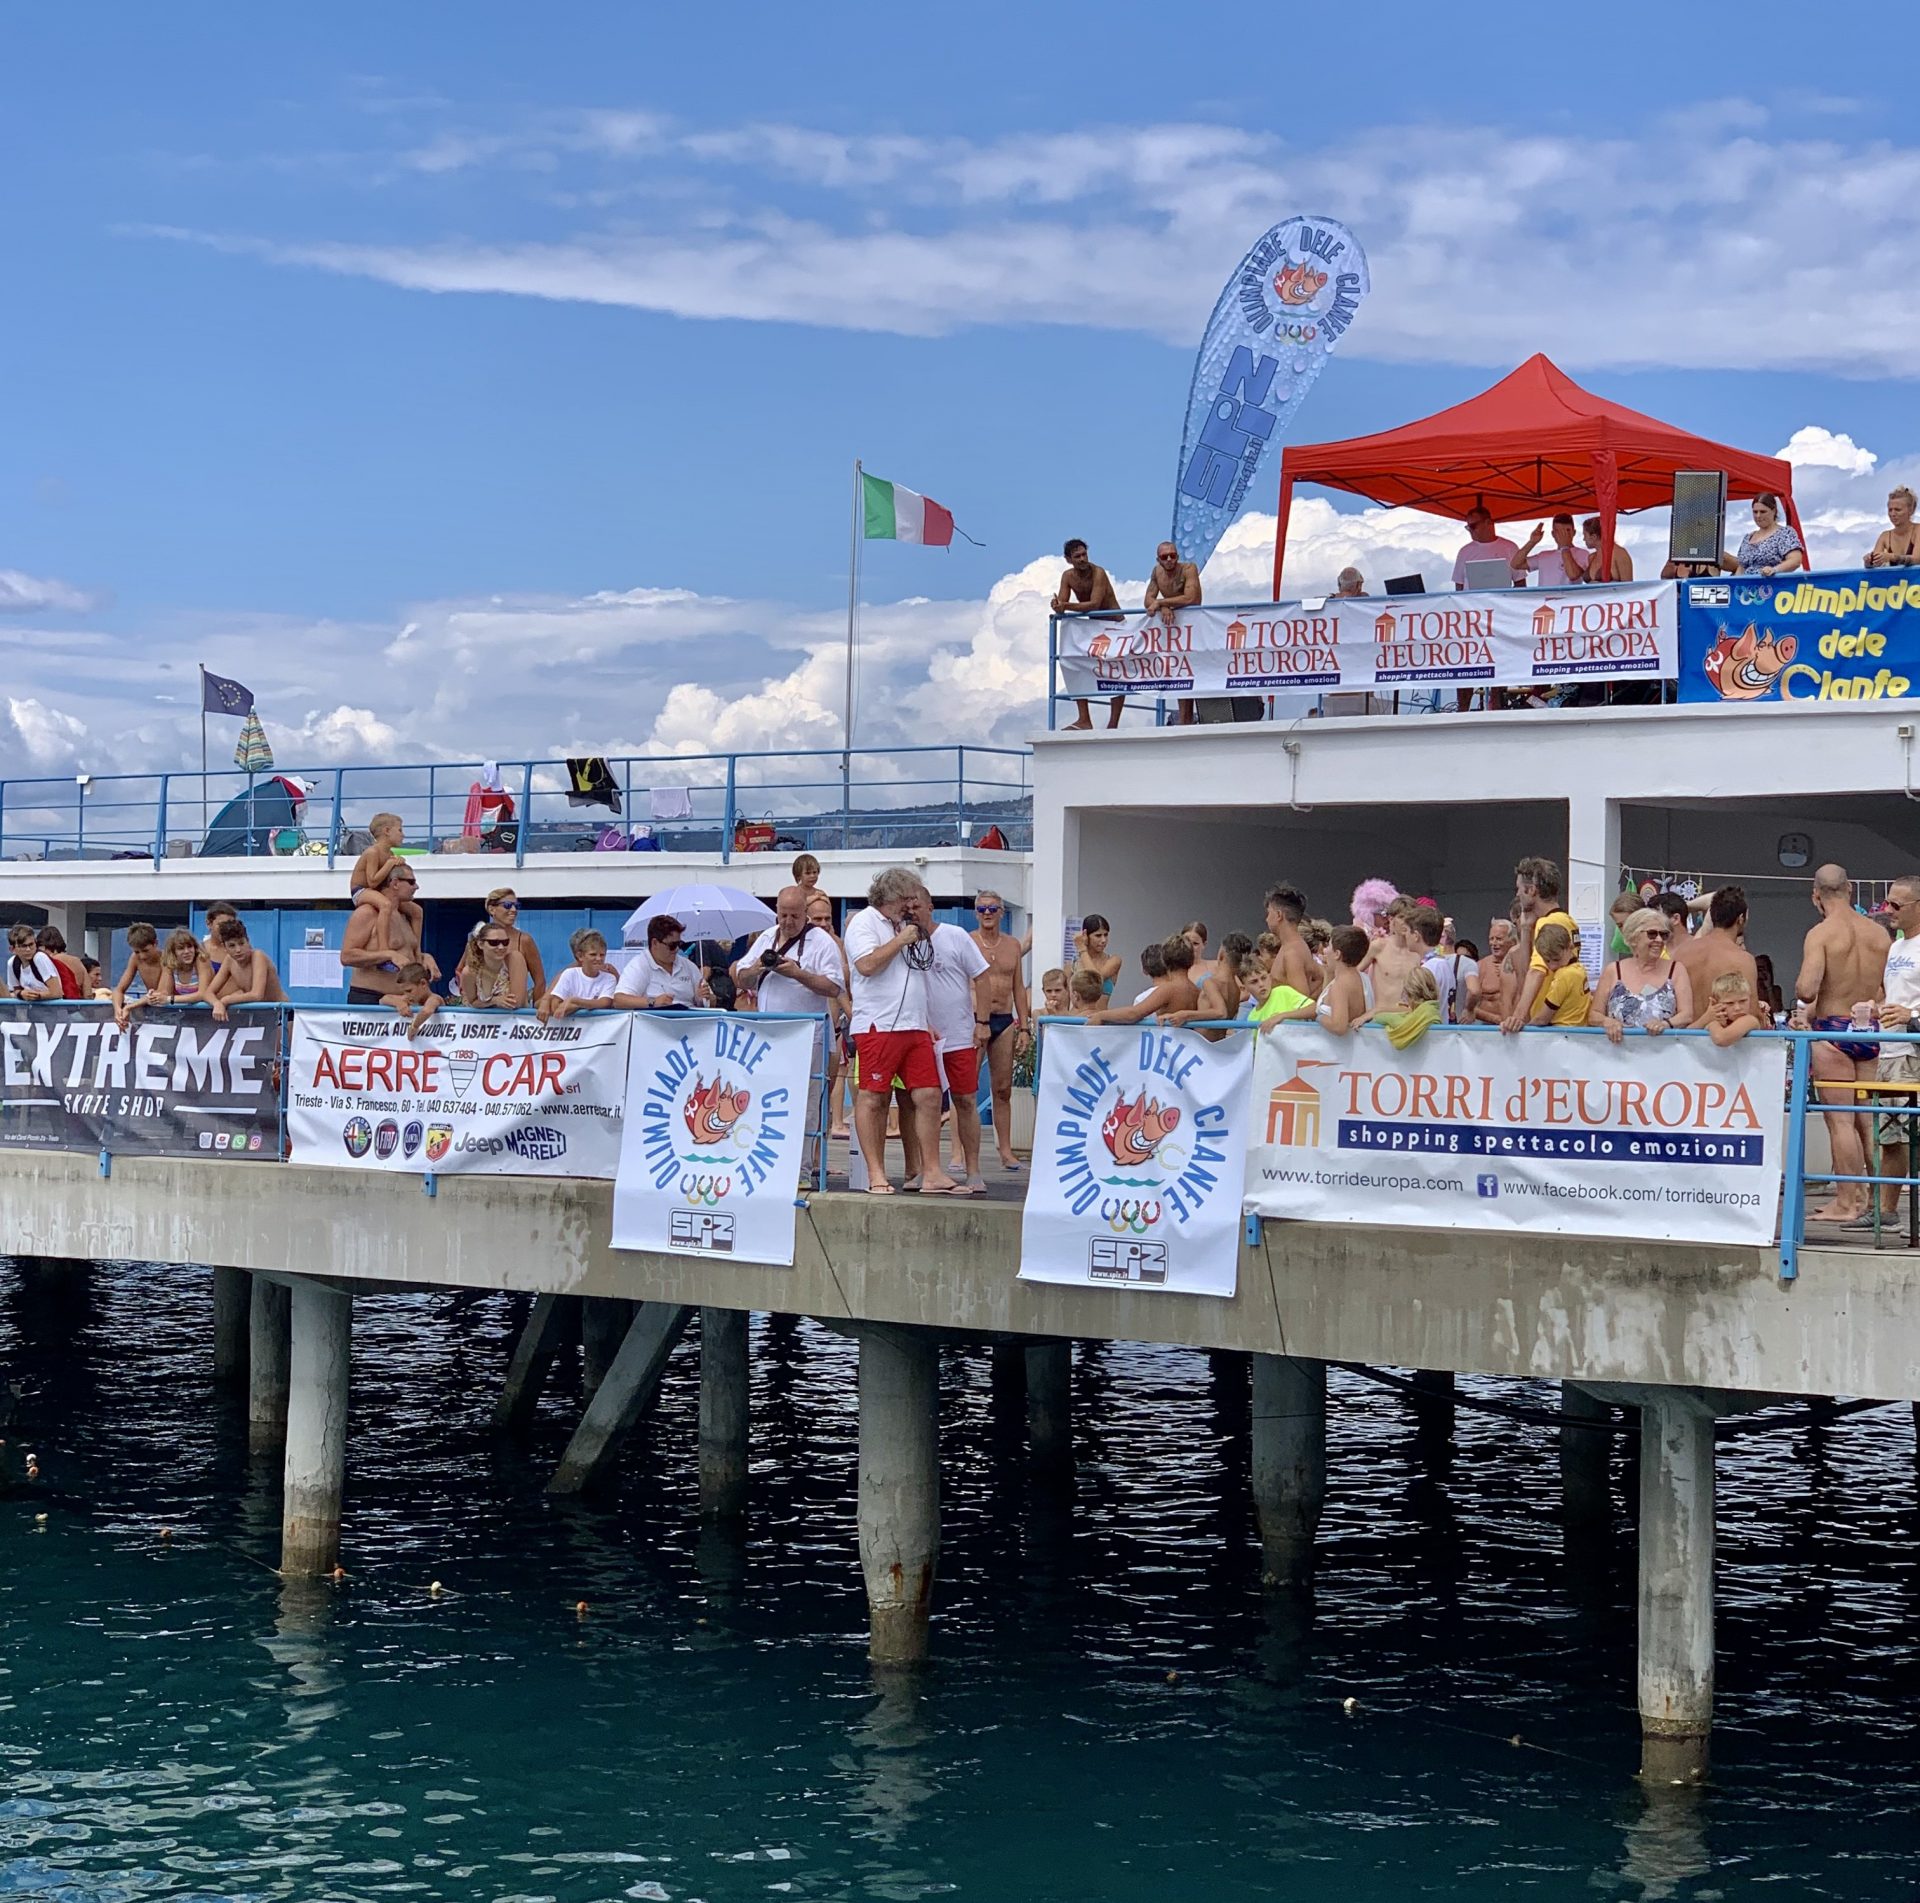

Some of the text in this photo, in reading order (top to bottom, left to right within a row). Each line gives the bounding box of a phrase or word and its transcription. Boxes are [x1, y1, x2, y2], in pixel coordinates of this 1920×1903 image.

[1239, 226, 1361, 343] OLIMPIADE DELE CLANFE
[1228, 437, 1264, 512] www.spiz.it
[1774, 579, 1920, 618] olimpiade
[1250, 617, 1340, 649] TORRI
[1400, 608, 1496, 642] TORRI
[1560, 598, 1660, 634] TORRI
[1116, 625, 1193, 659] TORRI
[1375, 639, 1496, 669] d'EUROPA
[1533, 631, 1660, 662] d'EUROPA
[1818, 626, 1887, 660] dele
[1227, 647, 1341, 676] d'EUROPA
[1378, 668, 1492, 681] shopping spettacolo emozioni
[1536, 661, 1657, 674] shopping spettacolo emozioni
[1229, 675, 1337, 687] shopping spettacolo emozioni
[342, 1021, 389, 1037] VENDITA
[460, 1024, 501, 1040] USATE
[509, 1025, 582, 1042] ASSISTENZA
[0, 1021, 266, 1095] EXTREME
[312, 1047, 442, 1093] AERRE
[482, 1052, 581, 1097] CAR srl
[64, 1093, 164, 1118] SKATE SHOP
[295, 1094, 323, 1108] Trieste
[330, 1096, 344, 1109] Via
[345, 1096, 353, 1110] S.
[356, 1097, 400, 1114] Francesco,
[401, 1099, 410, 1113] 60
[426, 1099, 441, 1113] 040
[442, 1100, 477, 1115] 637484
[541, 1103, 621, 1119] www.aerrecar.it
[642, 1021, 789, 1197] OLIMPIADE DELE CLANFE
[1338, 1071, 1763, 1129] TORRI d'EUROPA
[379, 1131, 395, 1150] FIAT
[455, 1131, 504, 1156] Jeep
[1055, 1031, 1229, 1224] OLIMPIADE DELE CLANFE
[1350, 1124, 1746, 1158] shopping spettacolo emozioni
[1262, 1168, 1464, 1192] www.torrideuropa.com
